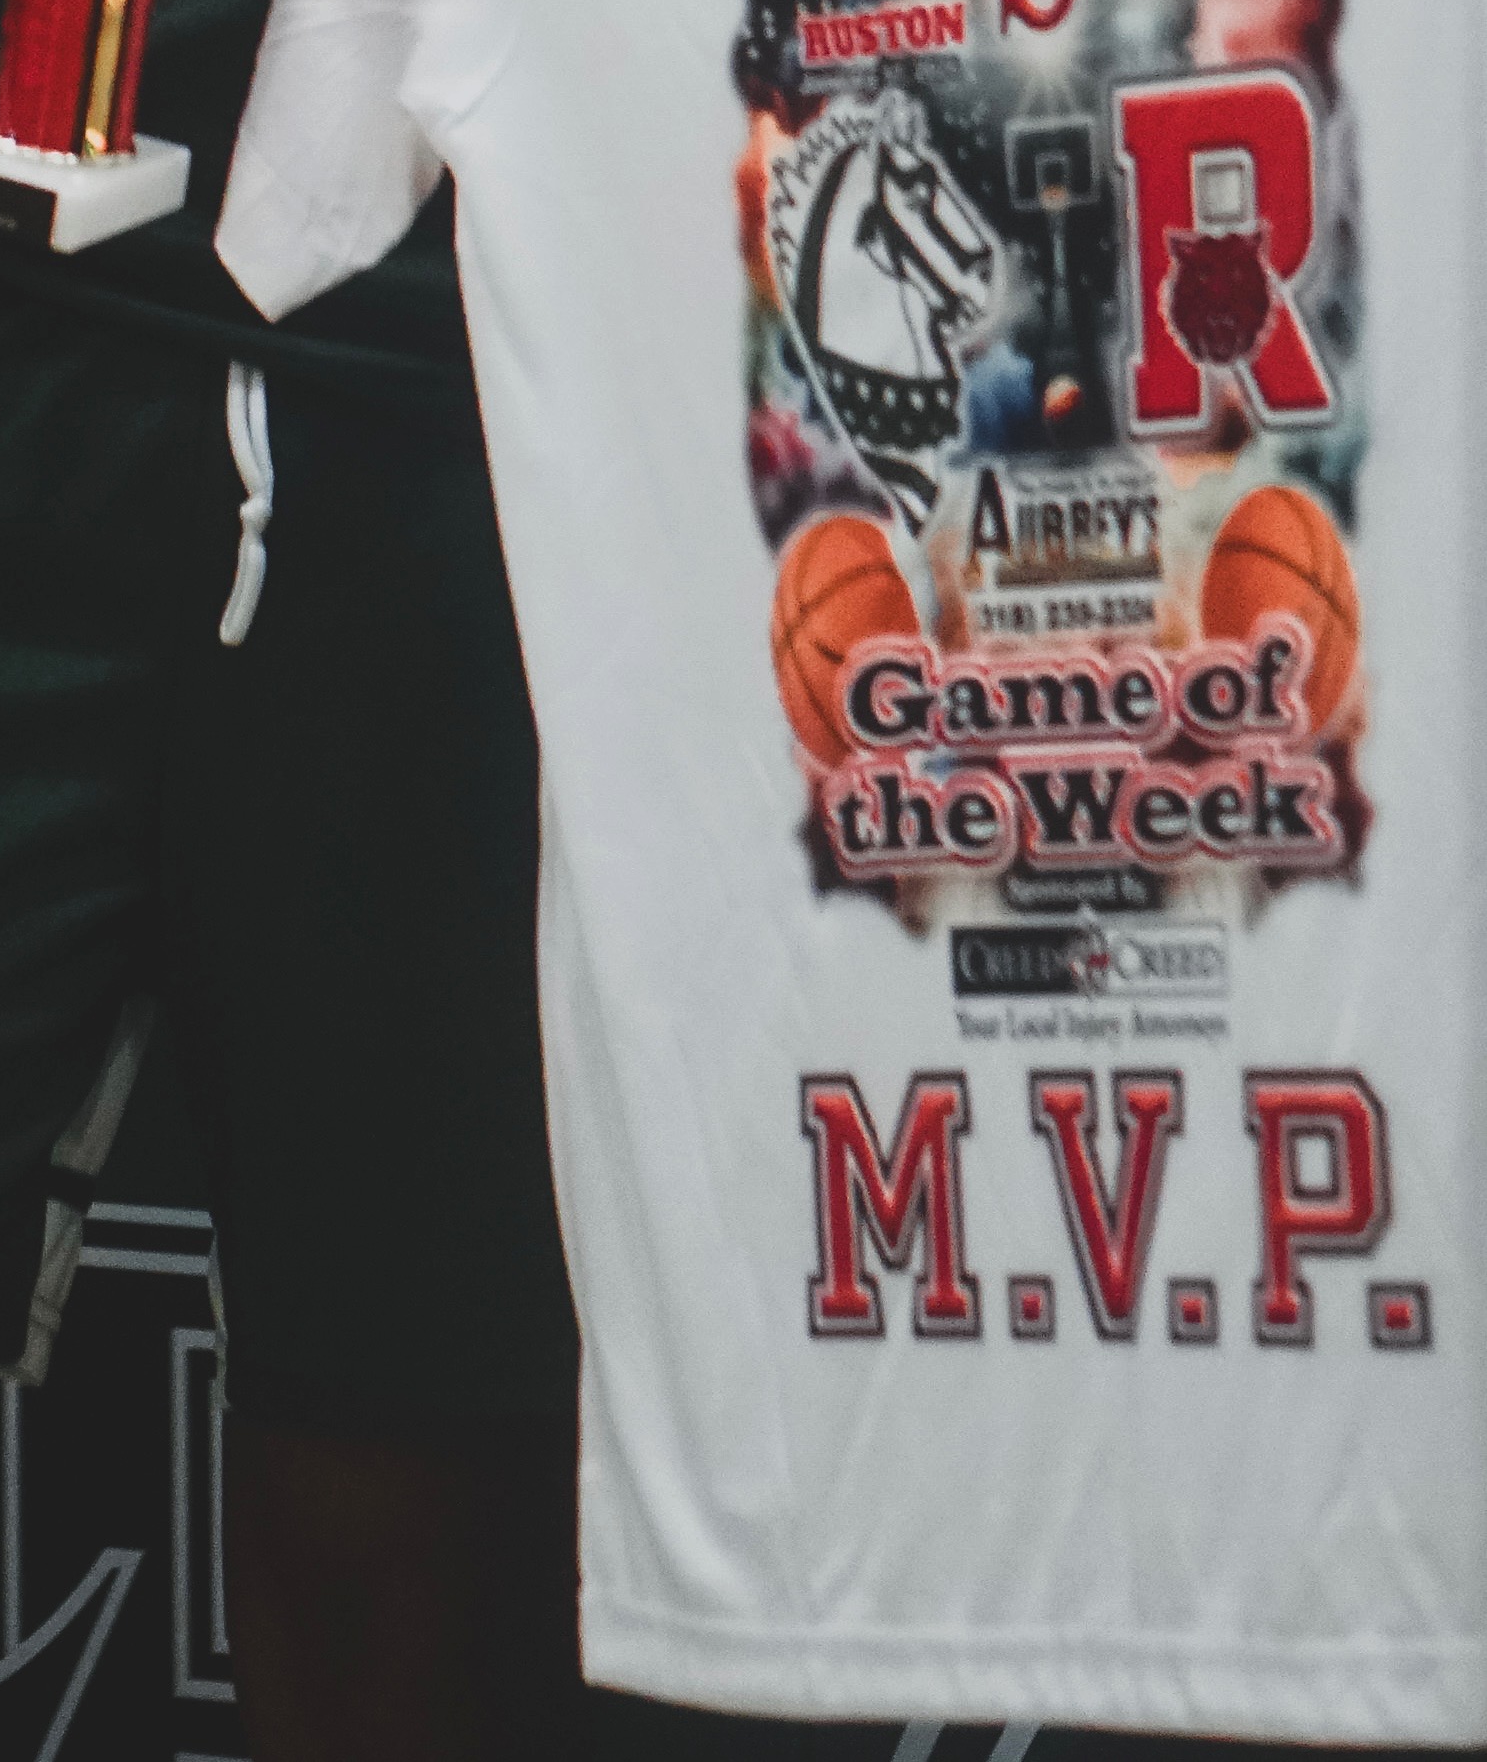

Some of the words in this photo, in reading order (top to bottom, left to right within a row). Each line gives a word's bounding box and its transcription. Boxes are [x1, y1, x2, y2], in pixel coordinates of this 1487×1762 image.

[798, 0, 968, 63] RUSTON
[847, 657, 1164, 745] Game
[1186, 638, 1295, 740] of
[836, 766, 1016, 854] the
[1017, 761, 1316, 851] Week
[800, 1067, 1435, 1353] M.V.P.
